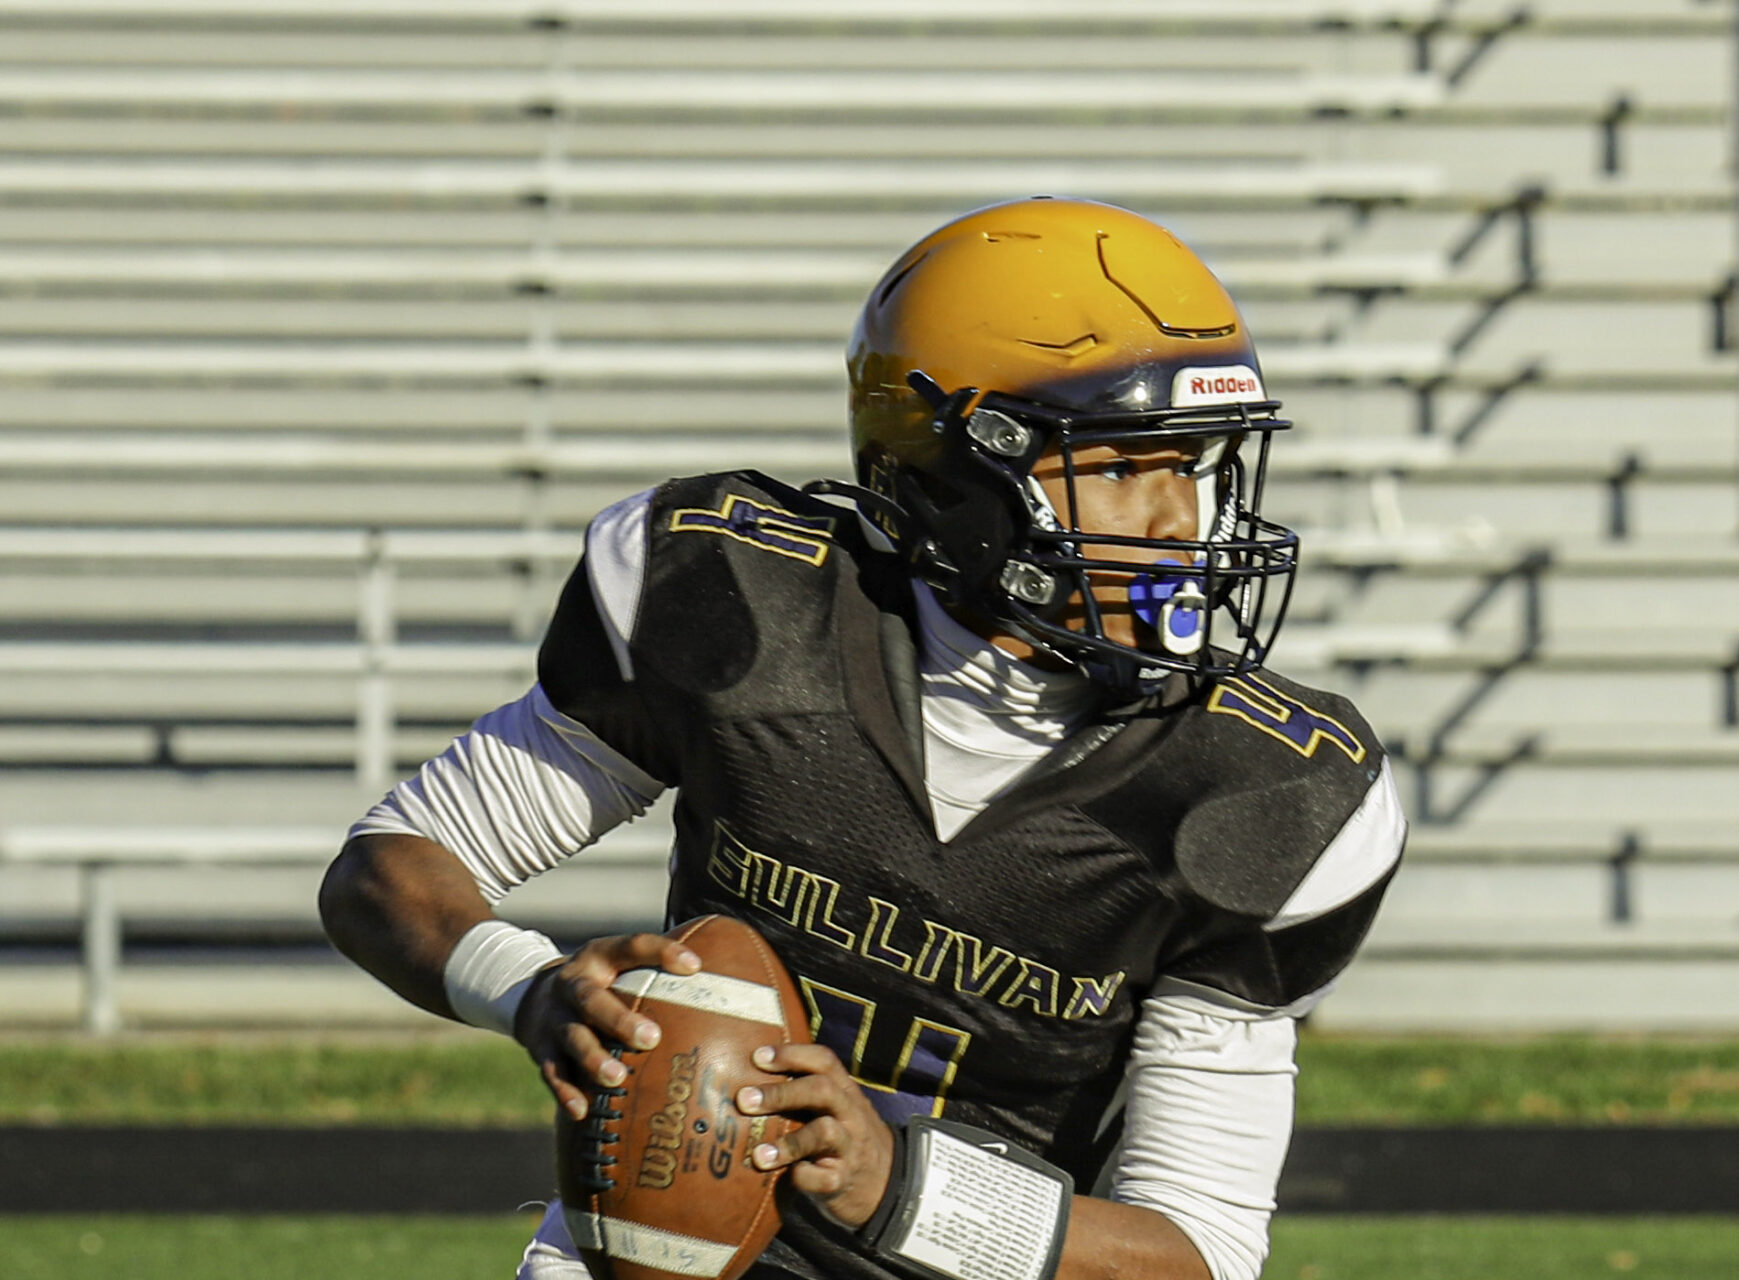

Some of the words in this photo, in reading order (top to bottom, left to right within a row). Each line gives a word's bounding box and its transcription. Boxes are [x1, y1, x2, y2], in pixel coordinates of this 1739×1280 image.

[669, 493, 837, 567] 4
[1207, 672, 1366, 764] 4
[707, 818, 1126, 1019] SULLIVAN
[637, 1047, 698, 1189] Wilson
